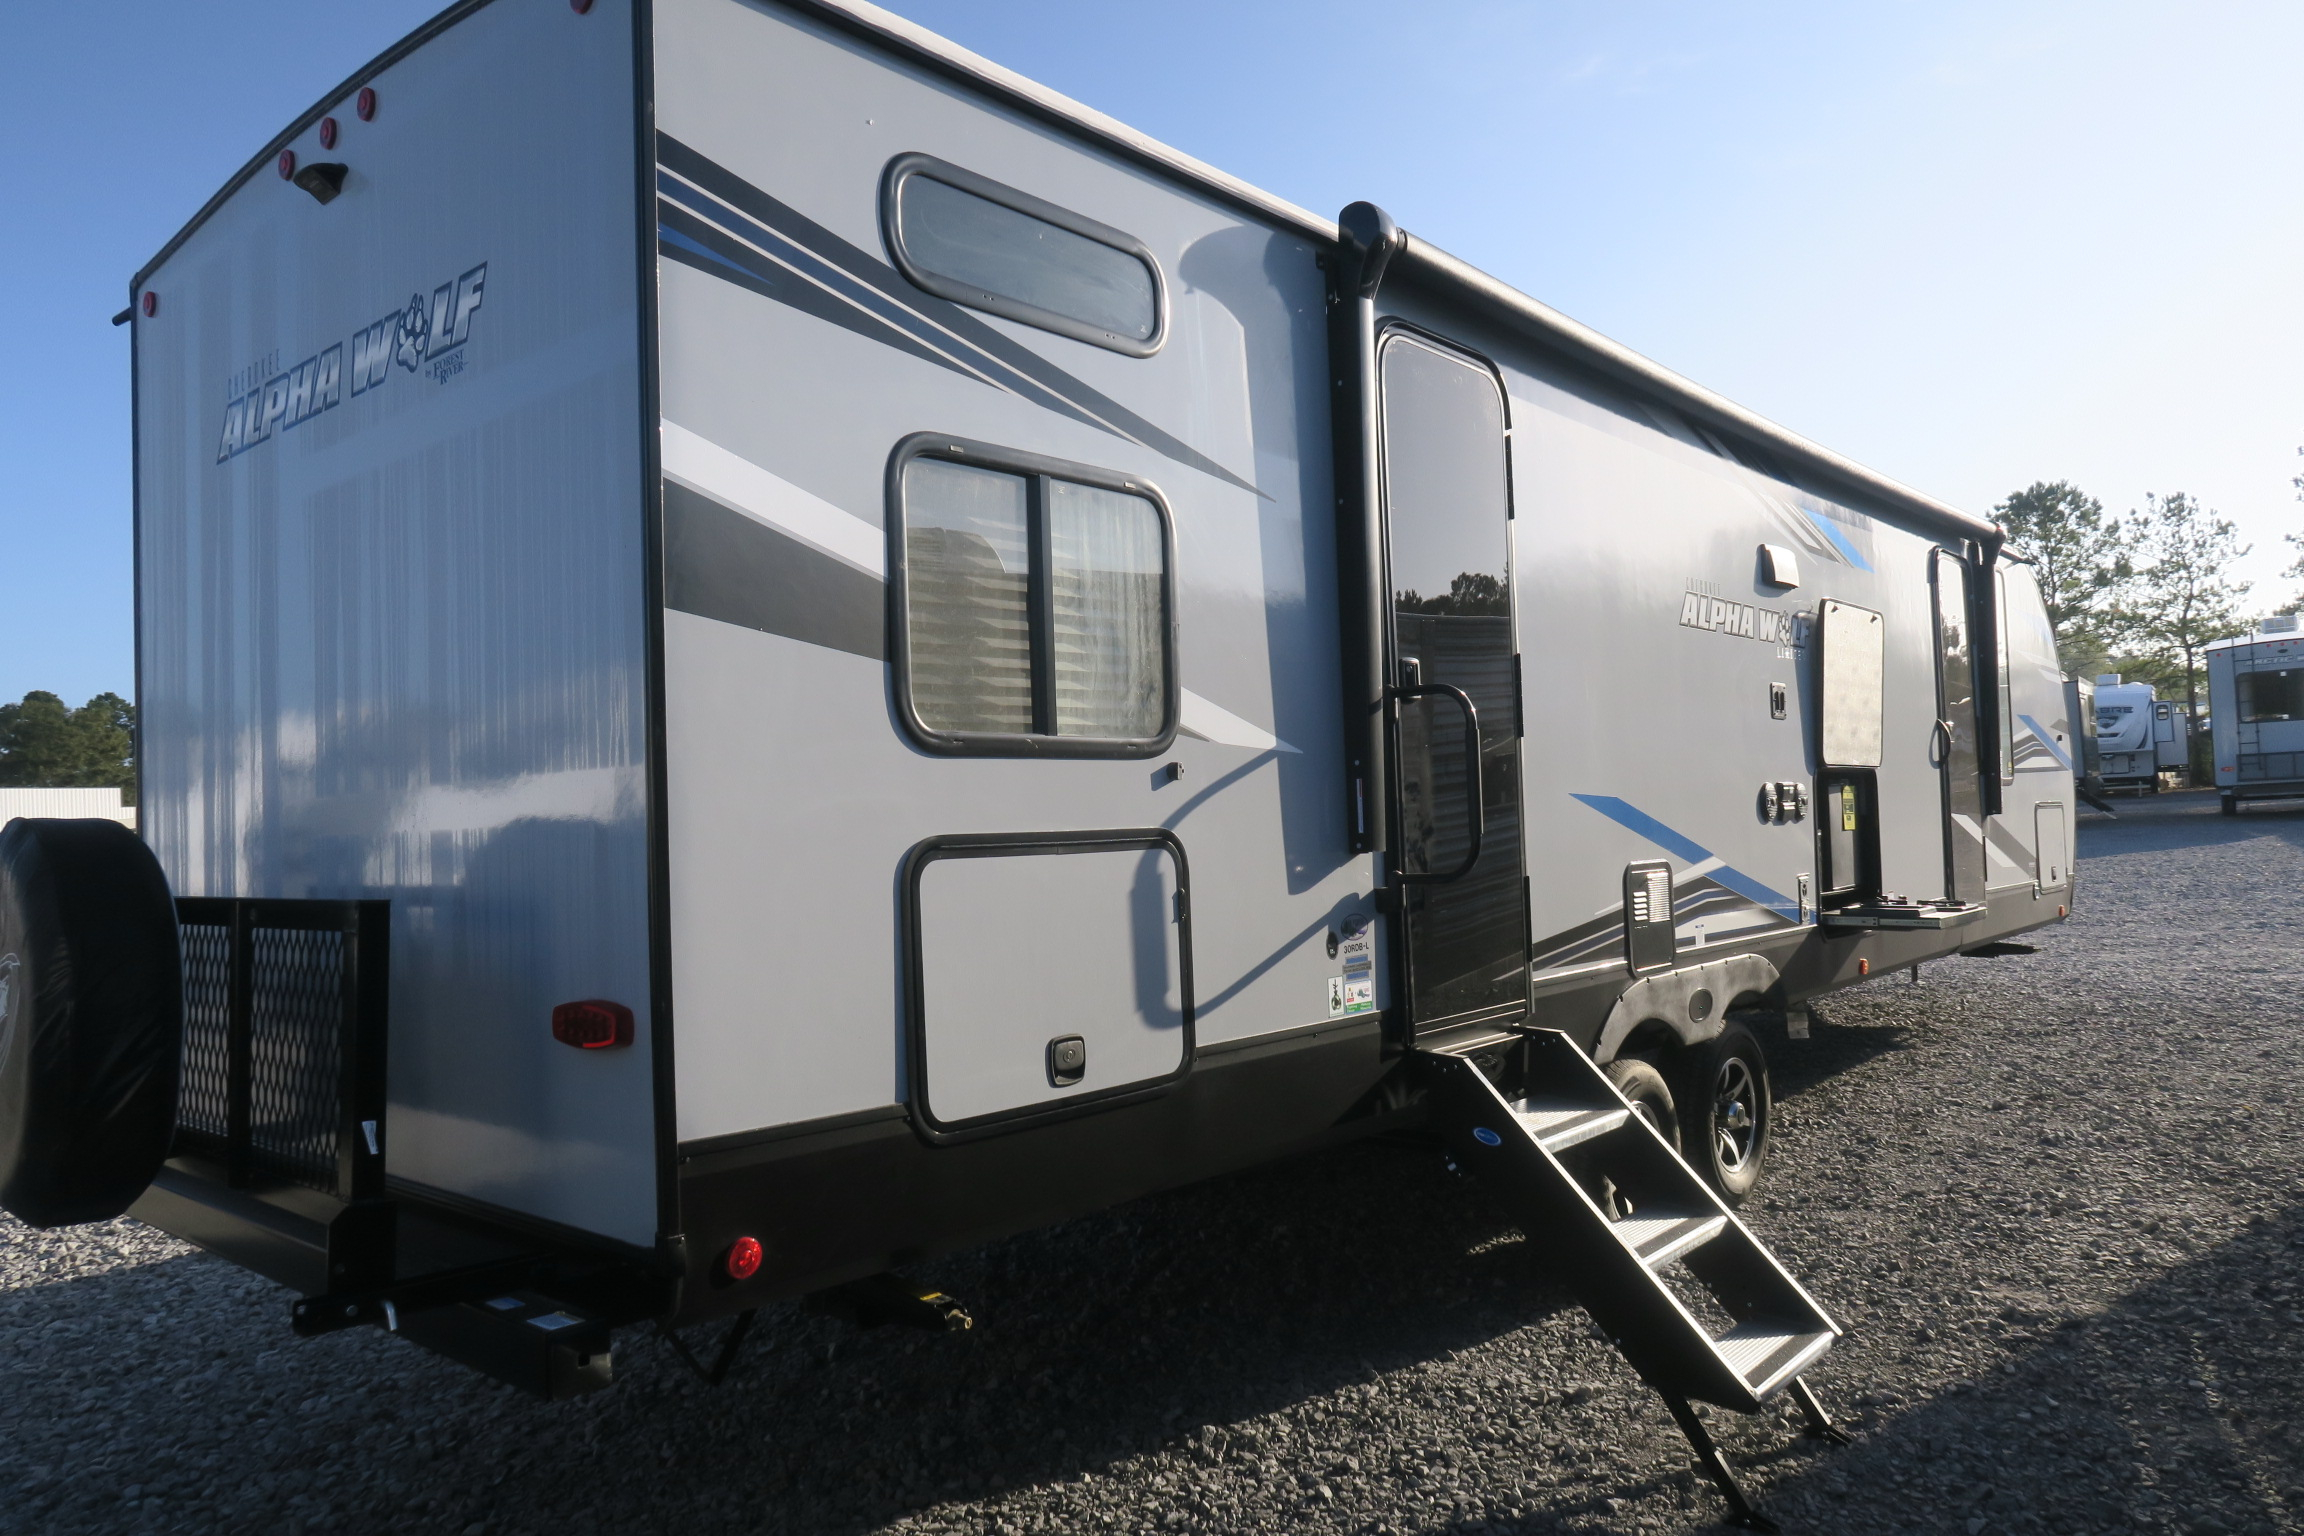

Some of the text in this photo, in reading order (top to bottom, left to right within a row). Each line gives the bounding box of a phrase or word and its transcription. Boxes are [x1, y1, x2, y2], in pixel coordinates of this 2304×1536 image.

[432, 349, 465, 380] FOREST
[440, 361, 469, 385] RIVER
[216, 341, 343, 465] ALPHA
[1679, 590, 1755, 639] ALPHA
[1343, 941, 1370, 954] 30RDB-L
